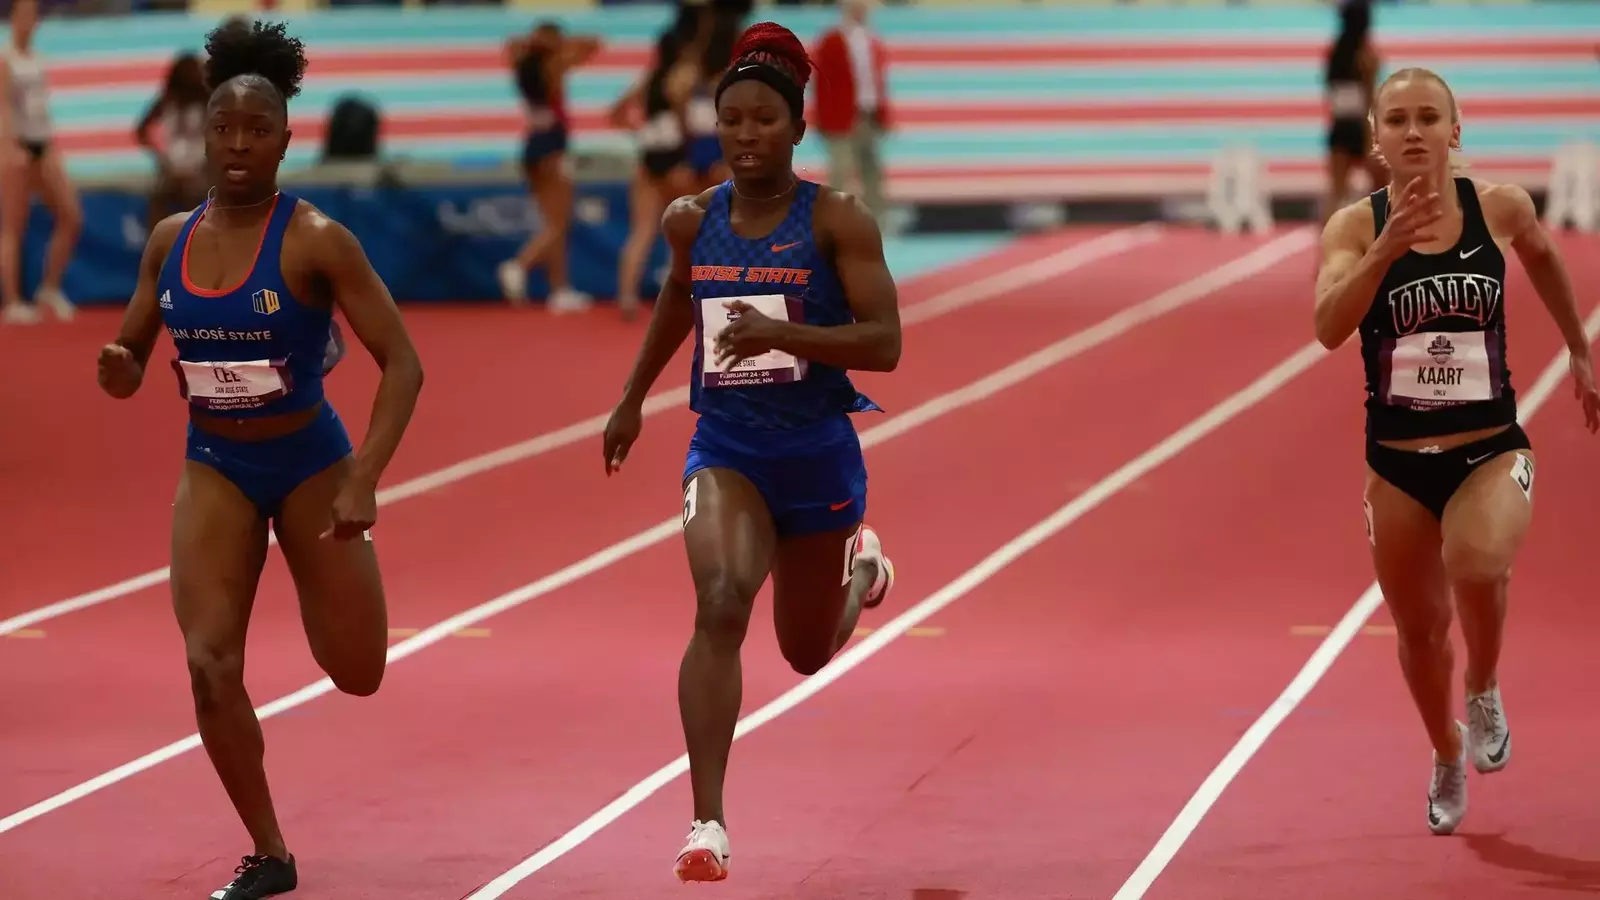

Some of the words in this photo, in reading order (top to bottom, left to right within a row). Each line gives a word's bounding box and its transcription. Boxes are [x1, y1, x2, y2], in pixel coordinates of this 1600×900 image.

[691, 265, 745, 282] BOISE
[745, 267, 813, 285] STATE
[1388, 273, 1501, 336] UNLV
[168, 327, 191, 340] SAN
[192, 326, 228, 341] JOSÉ
[228, 330, 273, 341] STATE
[742, 359, 756, 367] STATE
[1417, 366, 1464, 386] KAART
